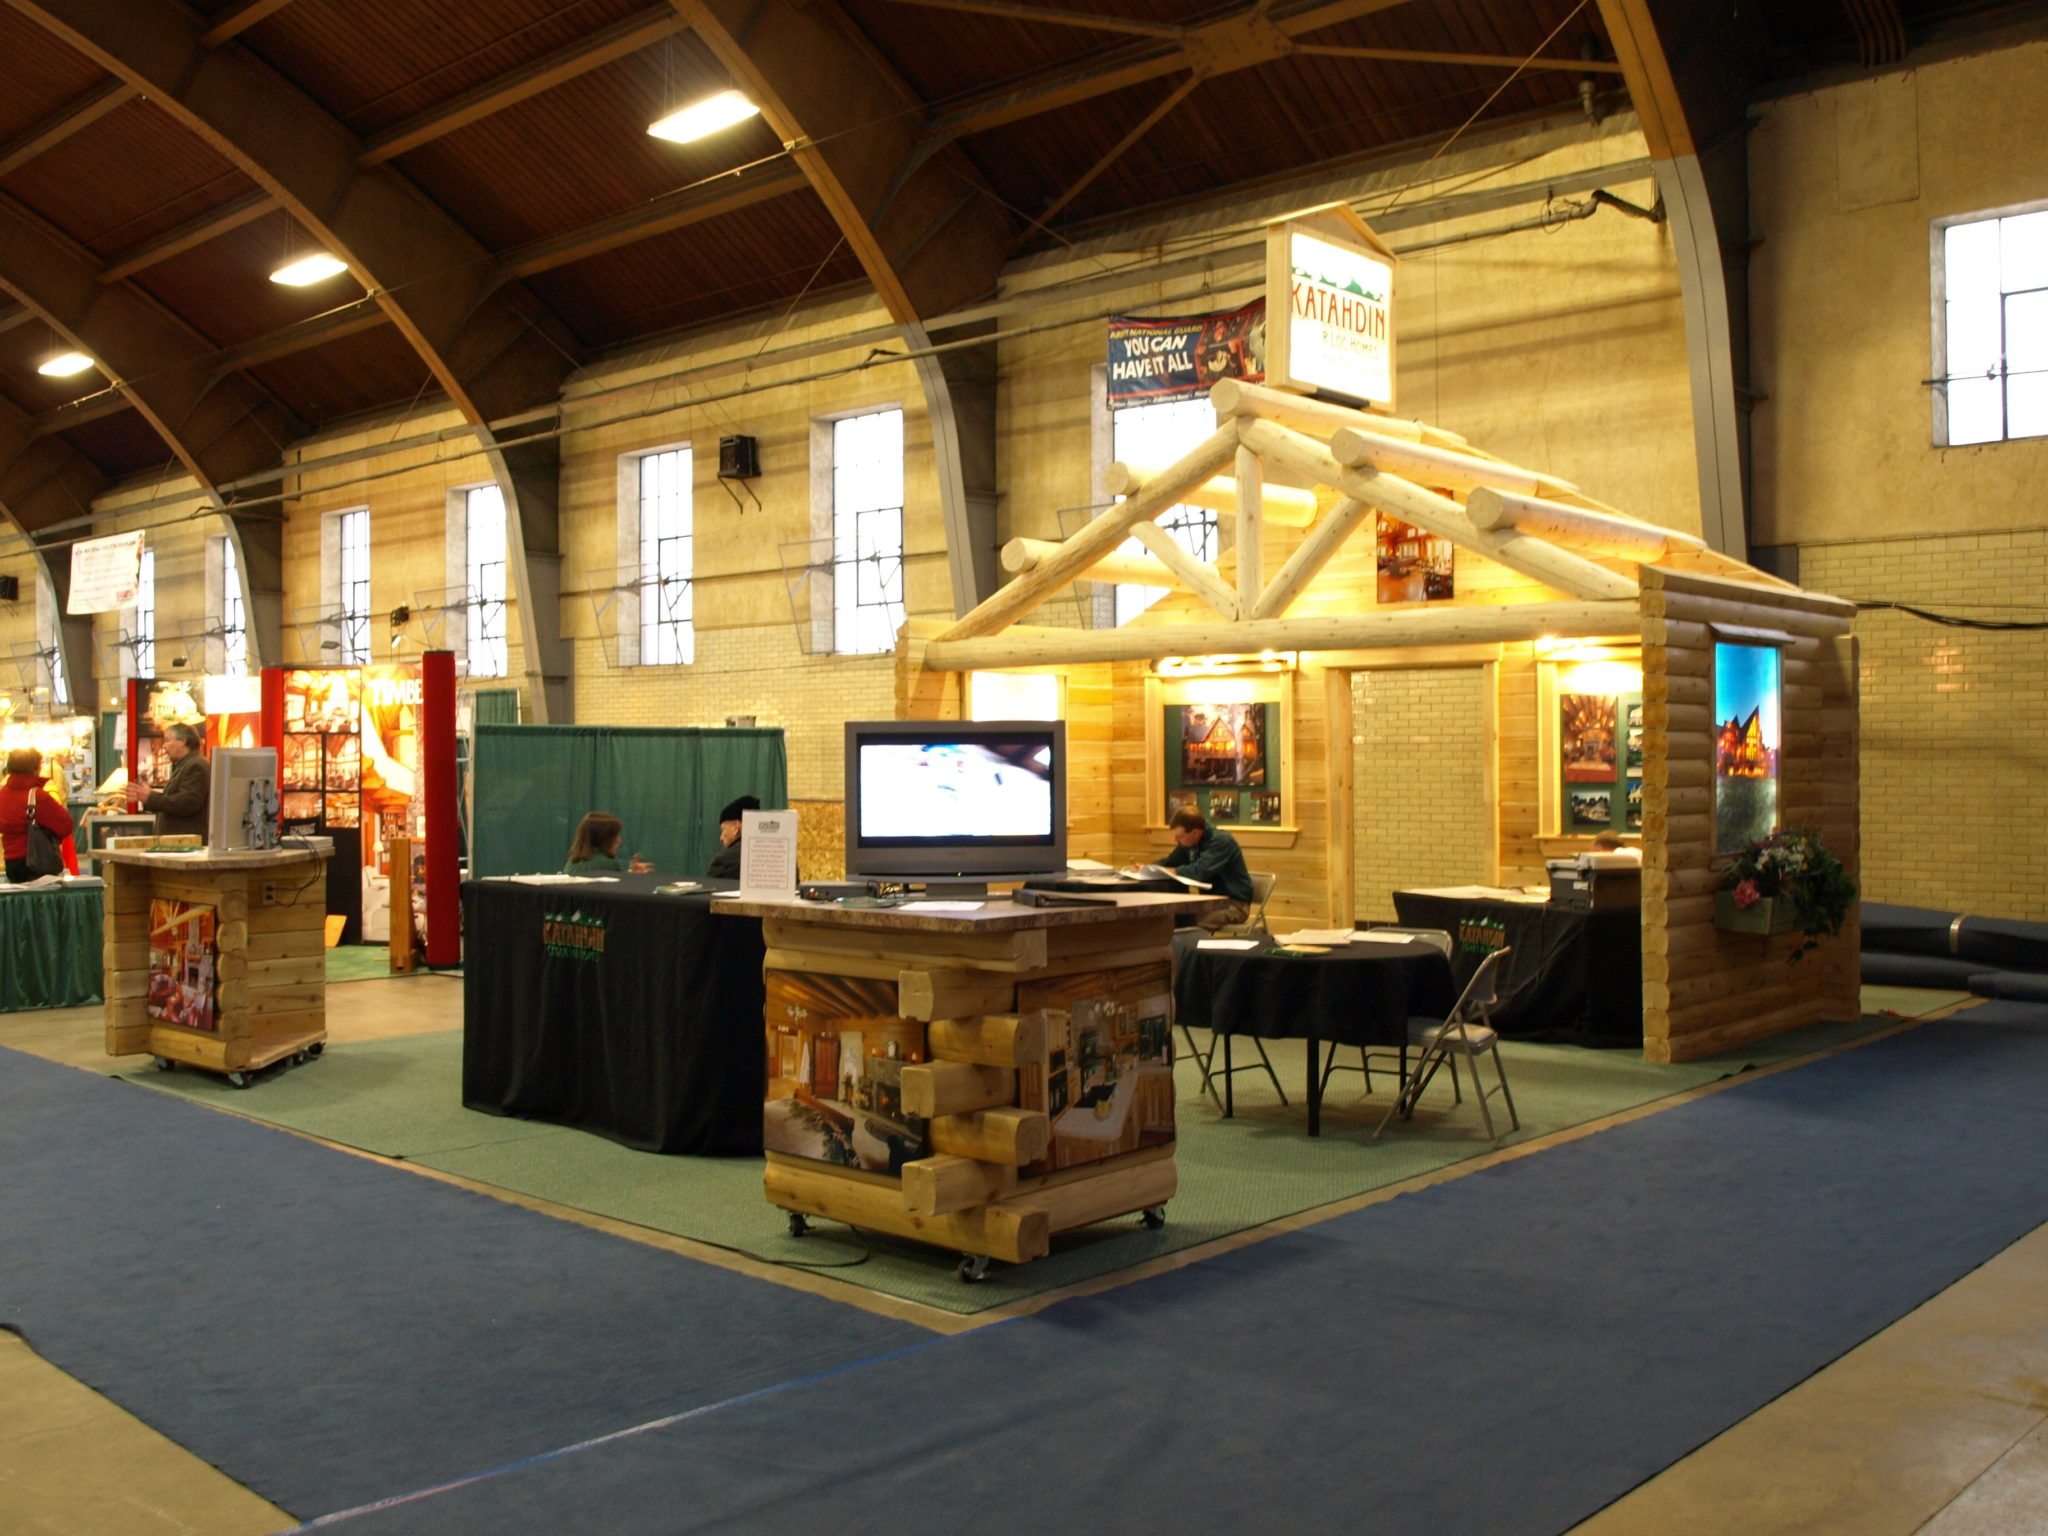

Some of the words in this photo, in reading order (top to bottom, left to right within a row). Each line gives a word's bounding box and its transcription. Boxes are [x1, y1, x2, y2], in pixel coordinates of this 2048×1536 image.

[1292, 280, 1385, 340] KATAHDIN
[1130, 327, 1173, 337] NATIONAL
[1174, 324, 1203, 335] GUARD
[1124, 337, 1150, 358] YOU
[1150, 335, 1187, 351] CAN
[1112, 360, 1152, 380] HAVE
[1152, 356, 1165, 375] IT
[1168, 351, 1193, 373] ALL
